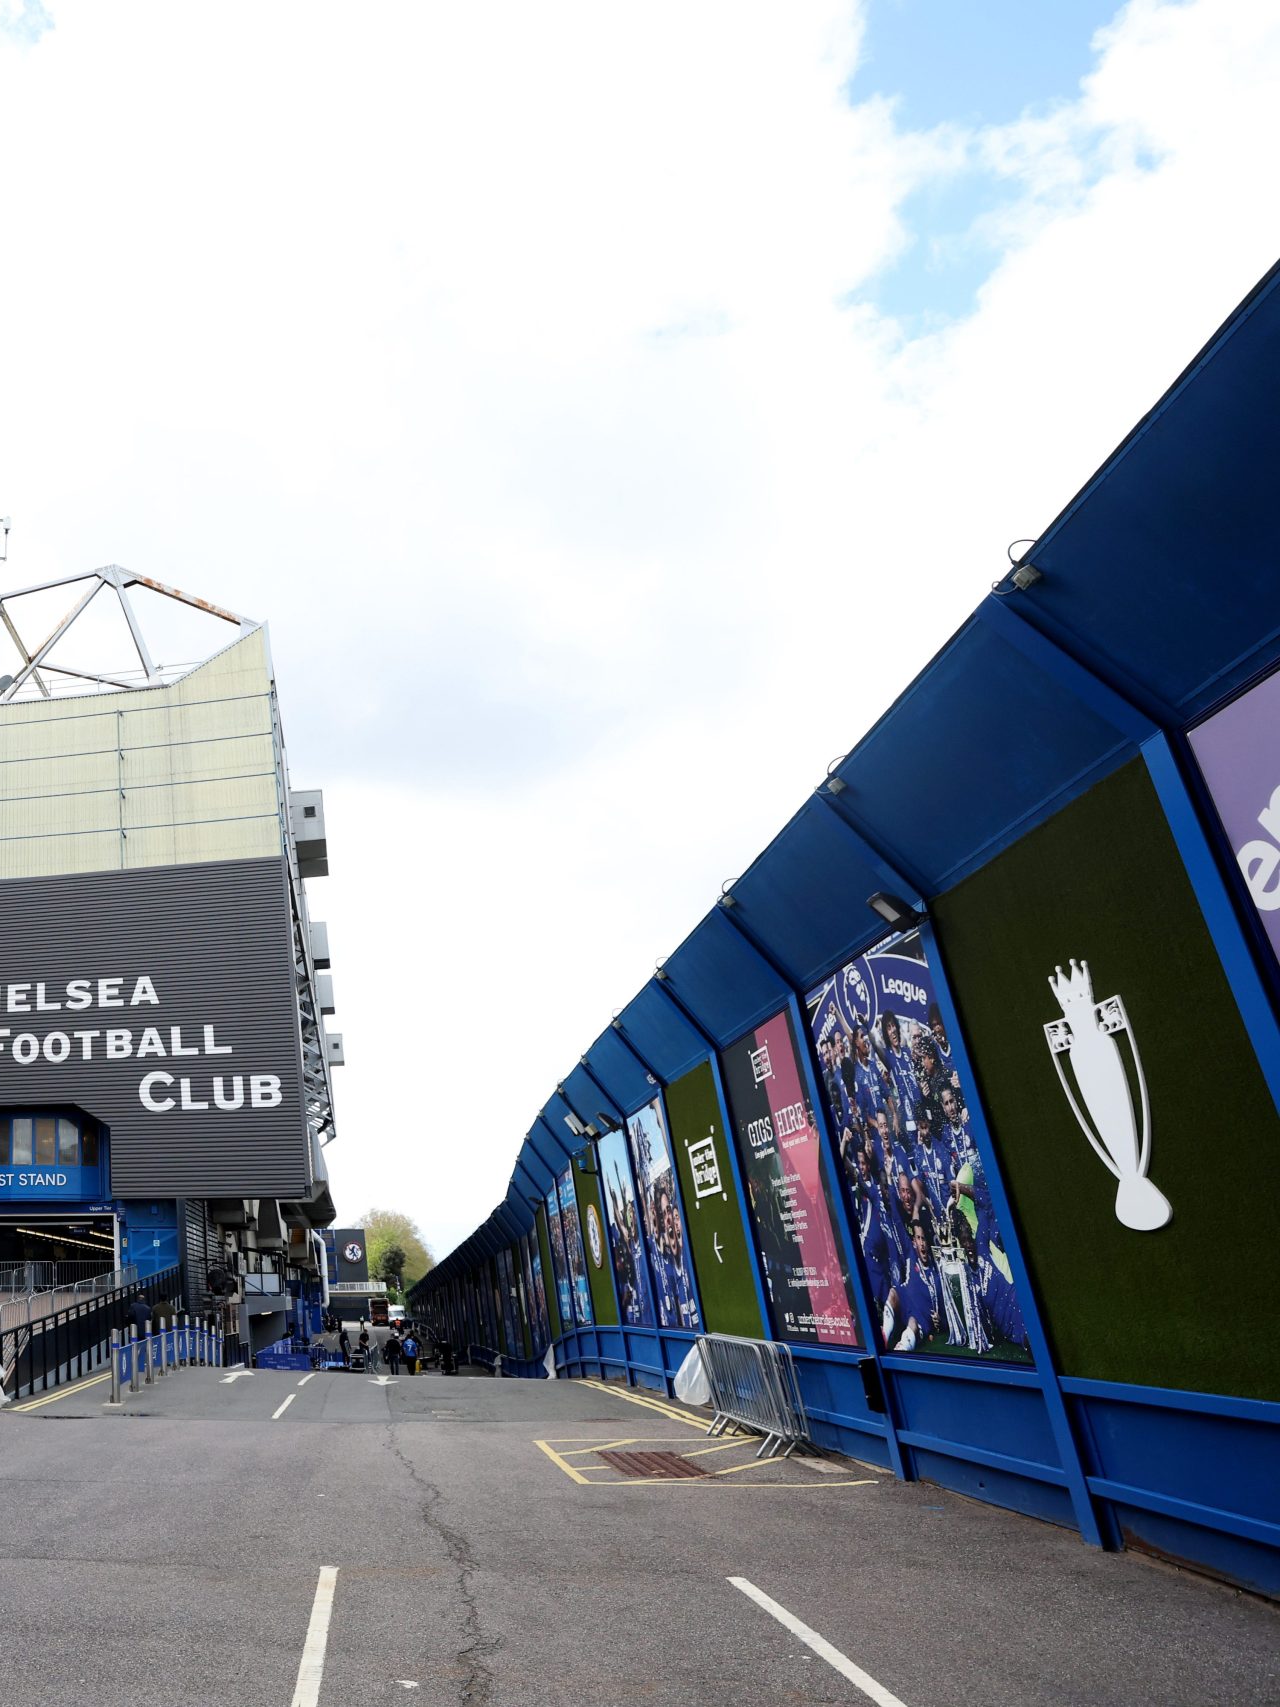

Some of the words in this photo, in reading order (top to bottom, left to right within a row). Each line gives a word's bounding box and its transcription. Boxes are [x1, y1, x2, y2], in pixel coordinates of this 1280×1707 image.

[881, 974, 927, 1005] League
[138, 1070, 283, 1113] CLUB
[748, 1116, 774, 1147] GIGS
[775, 1102, 806, 1137] HIRE
[18, 1173, 67, 1187] STAND
[694, 1163, 717, 1185] bridge
[407, 1344, 413, 1352] 7
